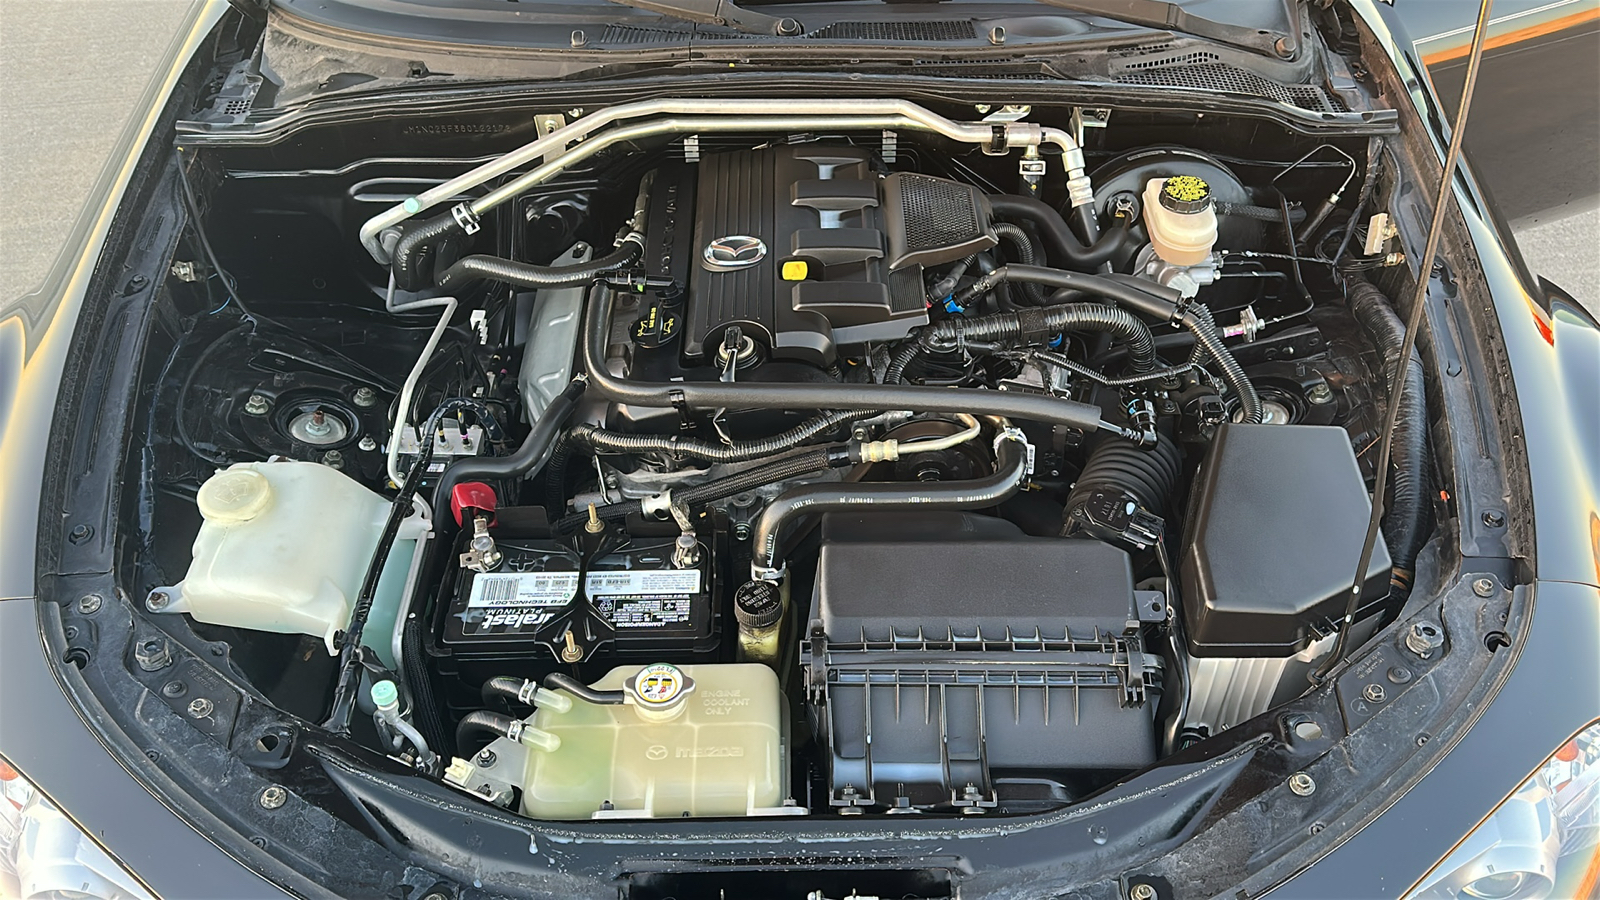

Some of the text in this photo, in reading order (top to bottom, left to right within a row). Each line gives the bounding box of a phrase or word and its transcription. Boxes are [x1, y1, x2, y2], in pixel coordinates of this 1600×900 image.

[701, 690, 741, 698] ENGINE
[703, 698, 750, 706] COOLANT
[705, 707, 732, 716] ONLY
[676, 746, 744, 758] mazda
